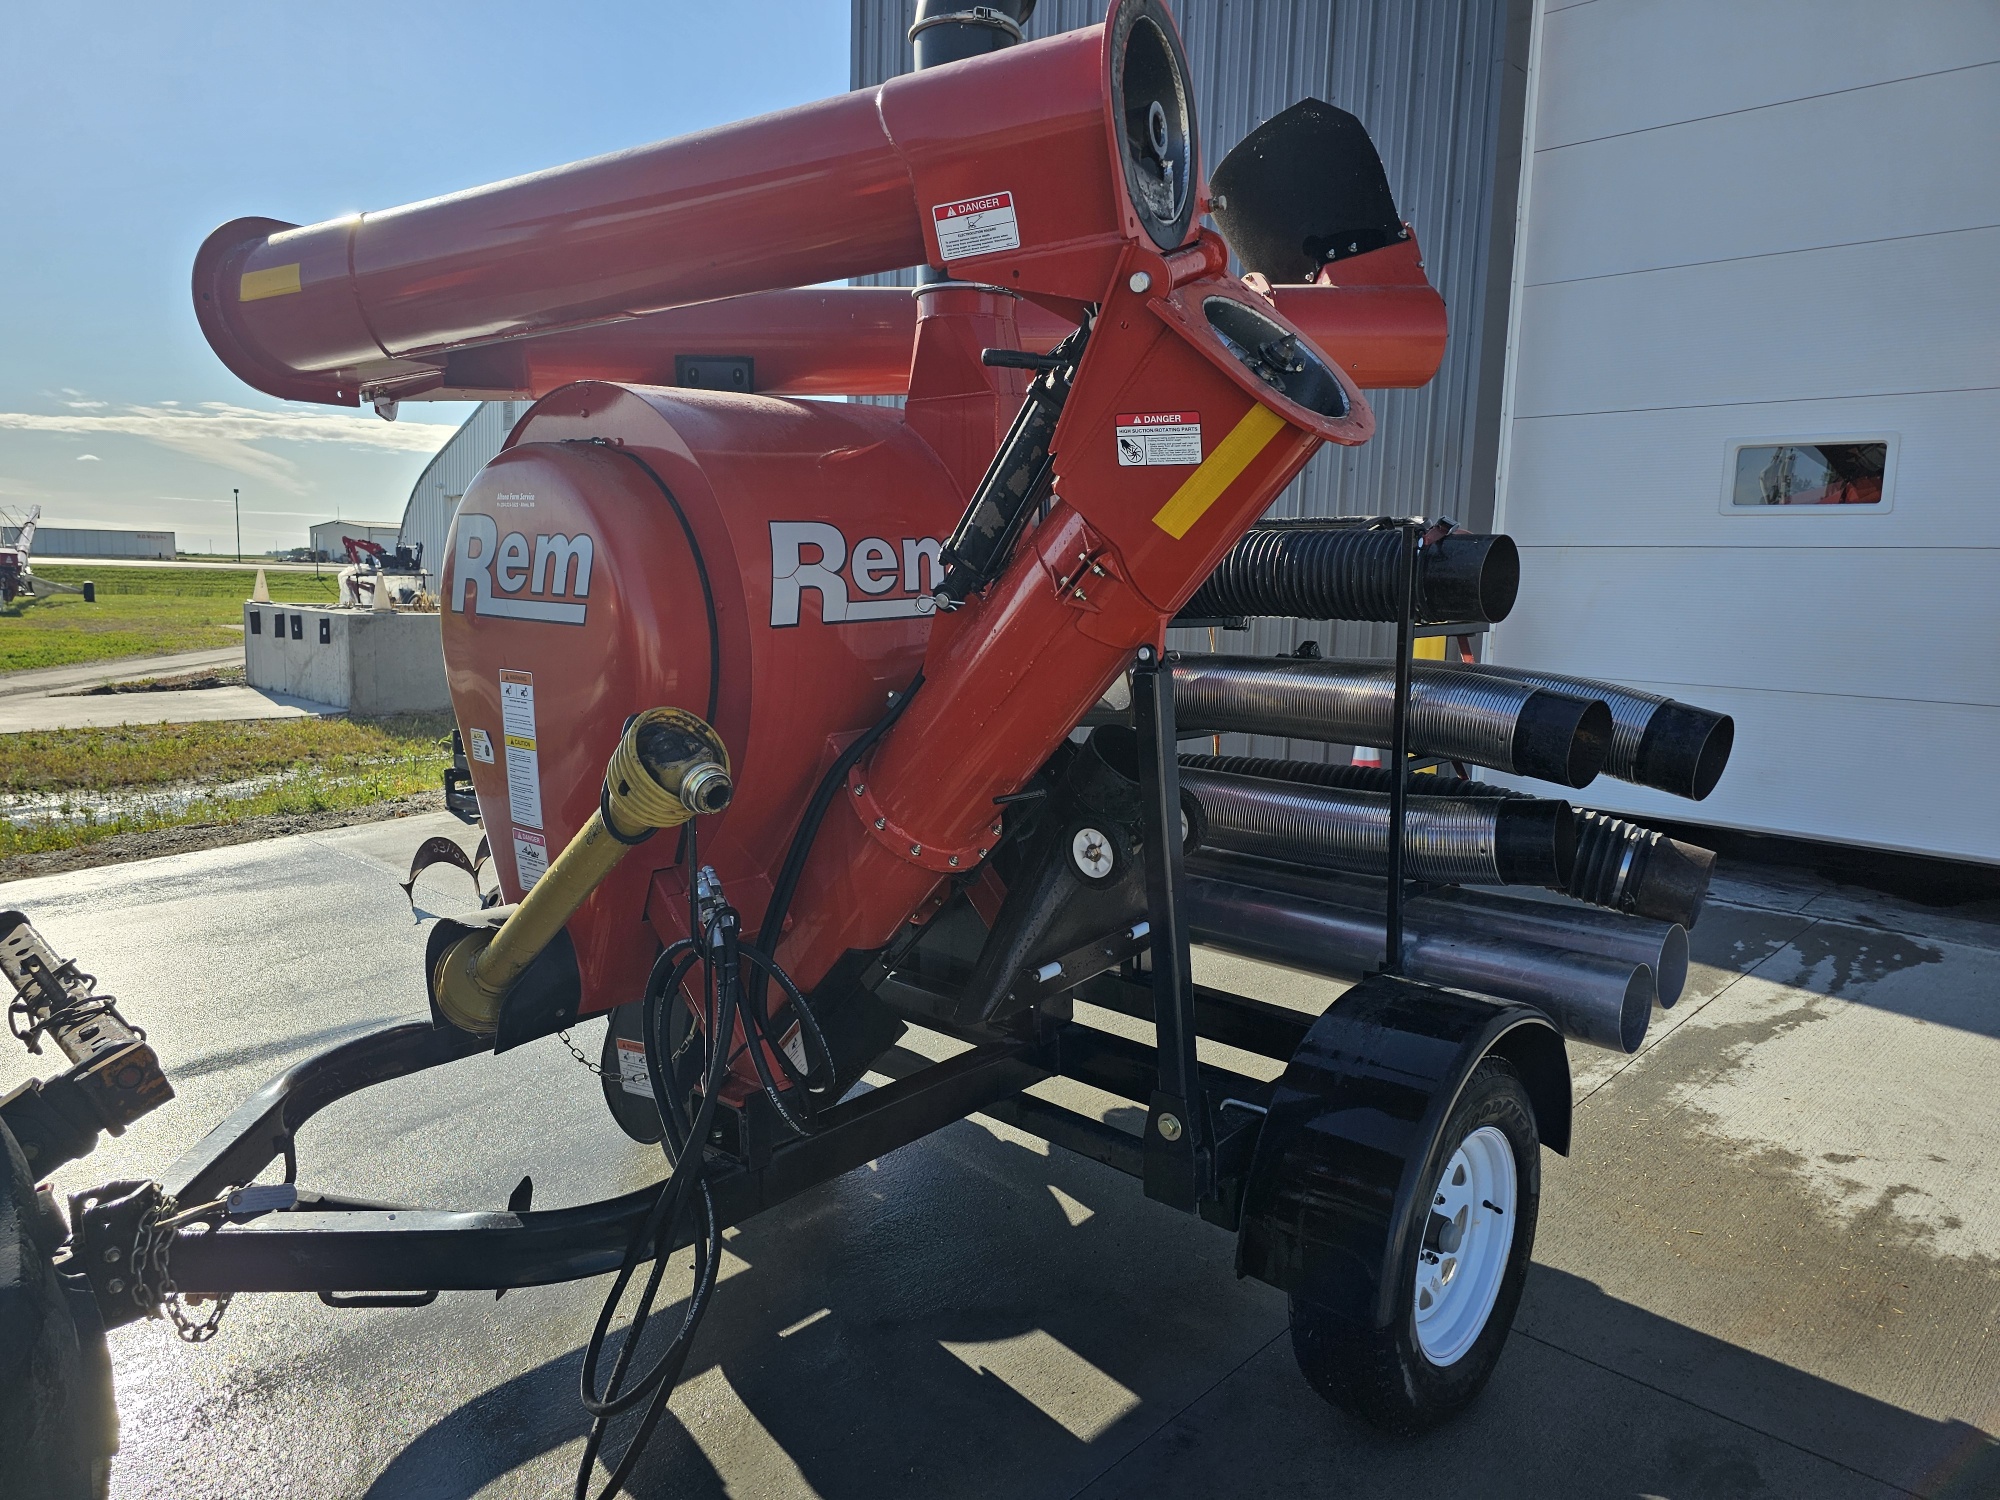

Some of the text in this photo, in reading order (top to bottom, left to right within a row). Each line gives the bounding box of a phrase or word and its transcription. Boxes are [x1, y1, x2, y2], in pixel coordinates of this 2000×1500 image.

[958, 197, 1000, 214] DANGER
[1144, 414, 1182, 424] DANGER
[520, 492, 535, 500] Service
[451, 513, 594, 626] Rem
[514, 739, 531, 748] CAUTION
[522, 833, 541, 844] DANGER
[766, 1086, 788, 1120] PULSAR
